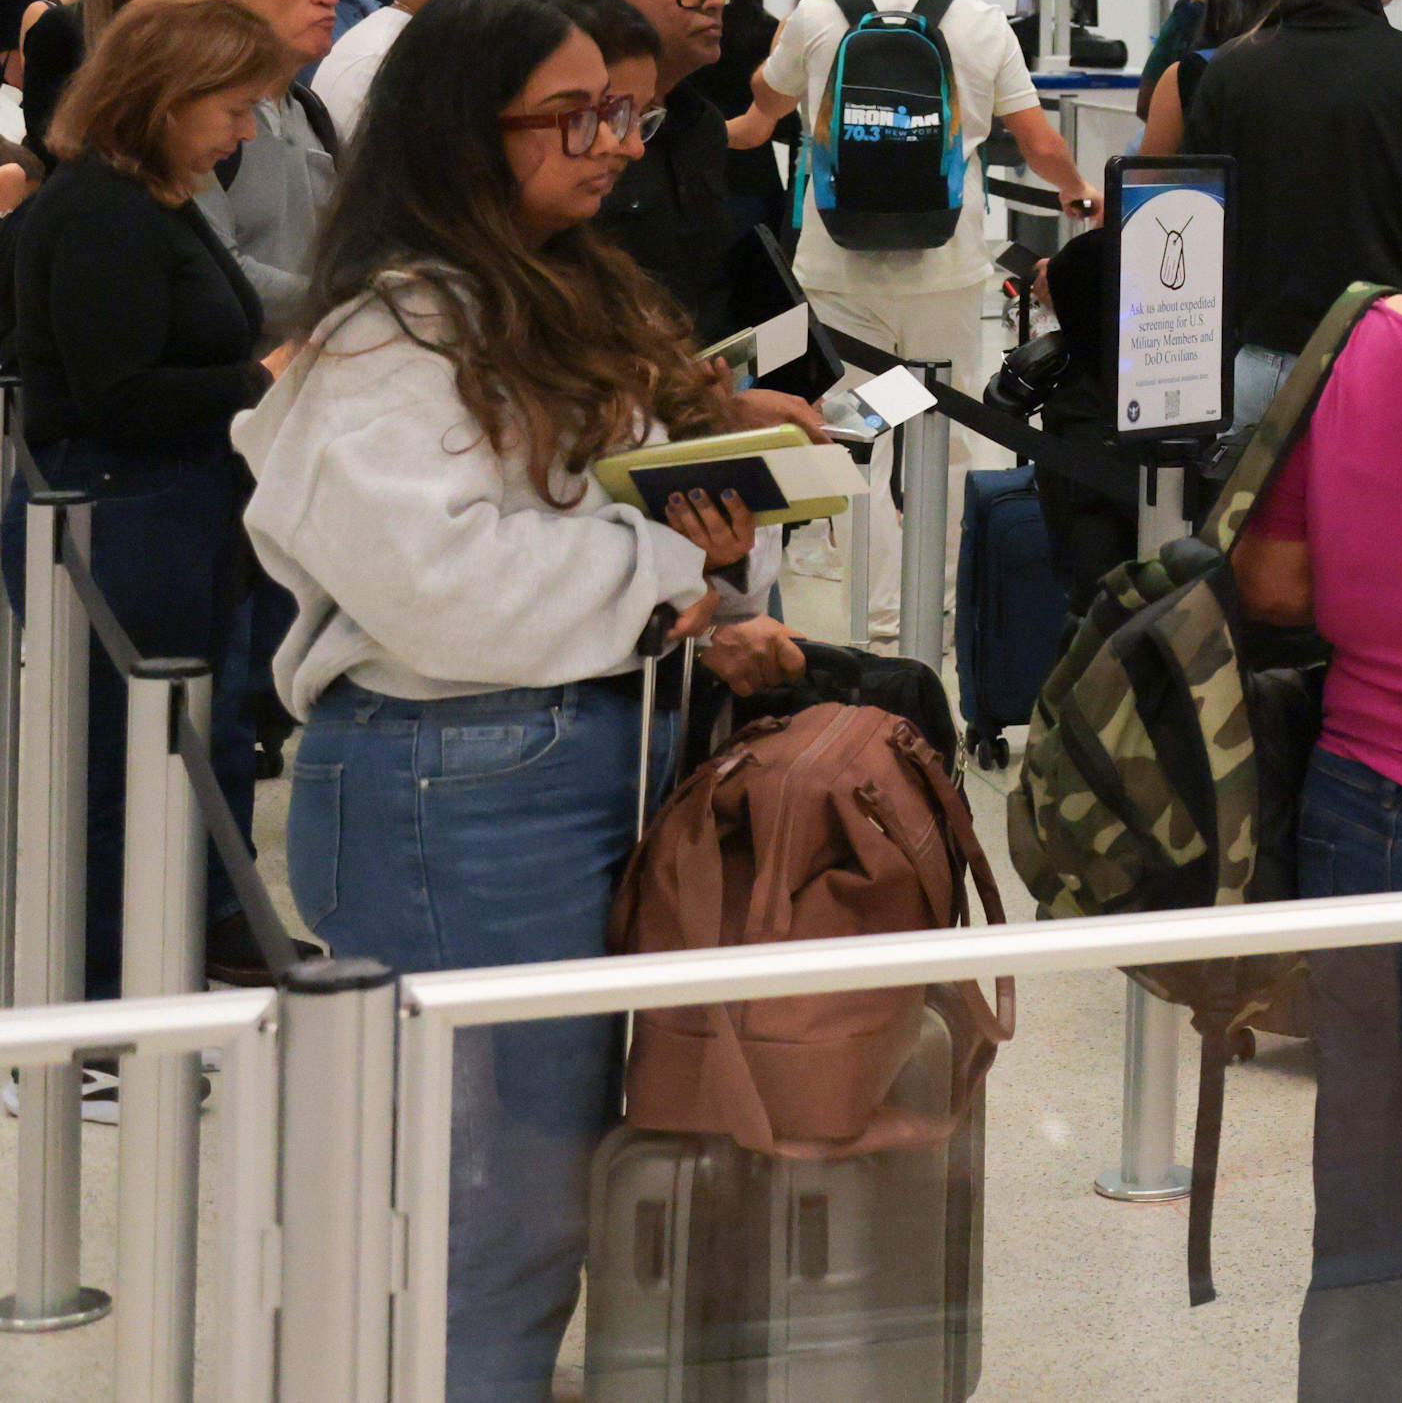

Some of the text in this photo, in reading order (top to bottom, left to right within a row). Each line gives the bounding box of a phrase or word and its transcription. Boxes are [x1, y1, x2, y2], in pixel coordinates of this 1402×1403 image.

[843, 125, 881, 142] 70.3
[1130, 296, 1216, 316] Ask us about expedited
[1138, 319, 1175, 333] screening
[1176, 315, 1188, 329] for
[1131, 329, 1215, 351] Military Members and
[1144, 351, 1163, 367] DoD
